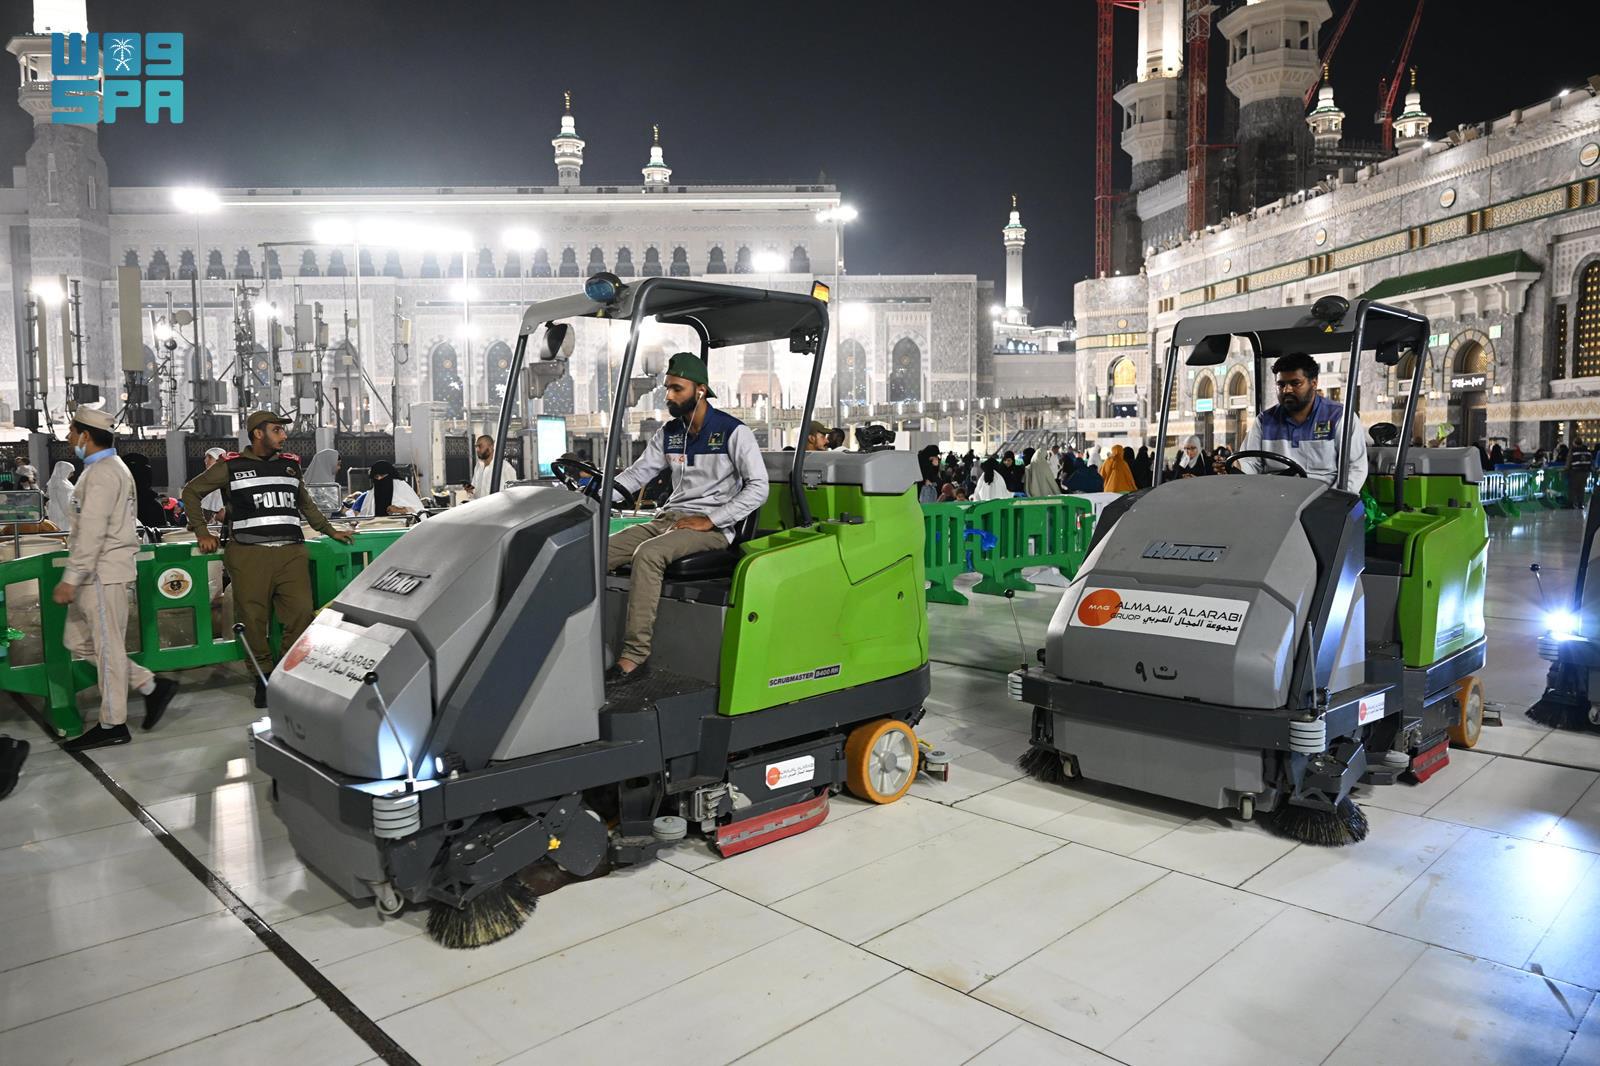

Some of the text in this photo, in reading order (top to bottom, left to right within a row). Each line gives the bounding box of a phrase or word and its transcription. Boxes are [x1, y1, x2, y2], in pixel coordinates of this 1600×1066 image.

[235, 470, 257, 479] 911
[252, 491, 297, 509] POLICE
[1110, 612, 1141, 621] GRUOP
[1115, 601, 1243, 623] ALMAJAL ALARABI
[1142, 615, 1239, 633] مجموعة المجال العربي
[769, 671, 814, 687] SCRUBMASTER
